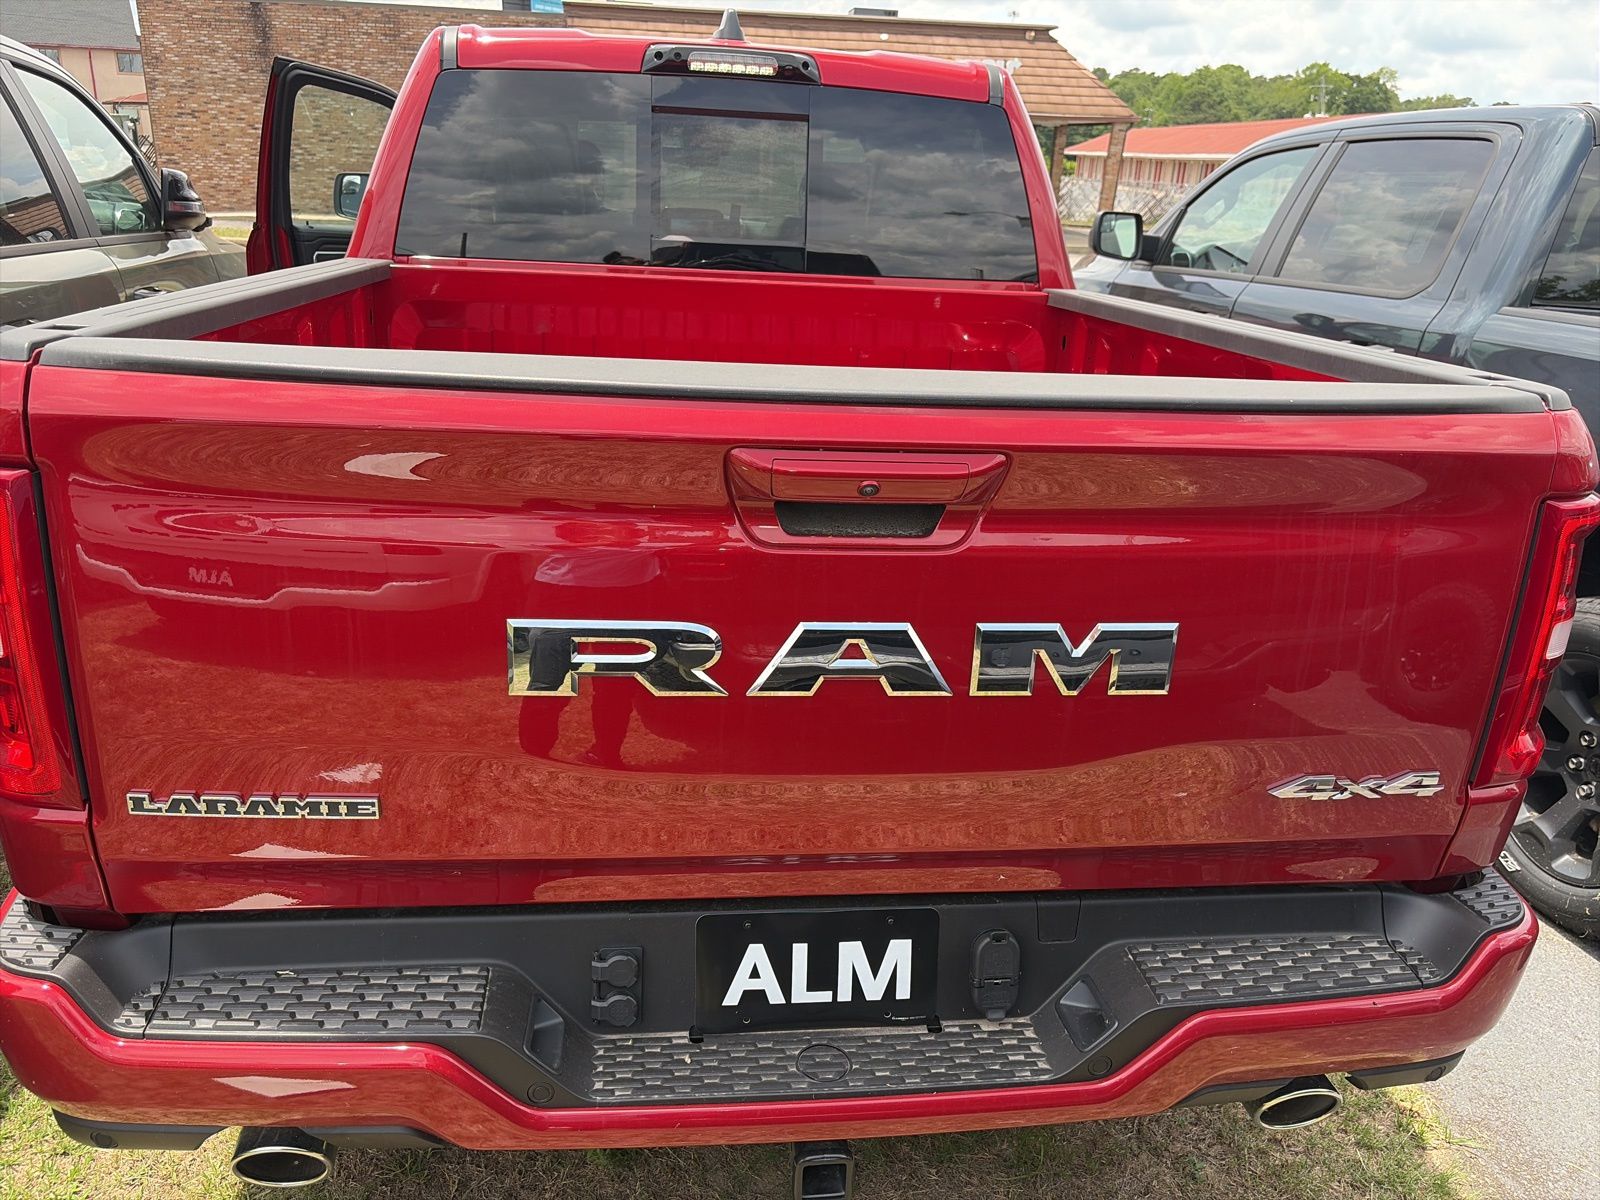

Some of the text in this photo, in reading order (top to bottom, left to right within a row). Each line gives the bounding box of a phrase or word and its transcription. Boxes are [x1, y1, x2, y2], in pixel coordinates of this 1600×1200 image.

[506, 618, 1180, 698] RAM
[126, 791, 380, 820] LARAMIE
[721, 938, 913, 1006] ALM
